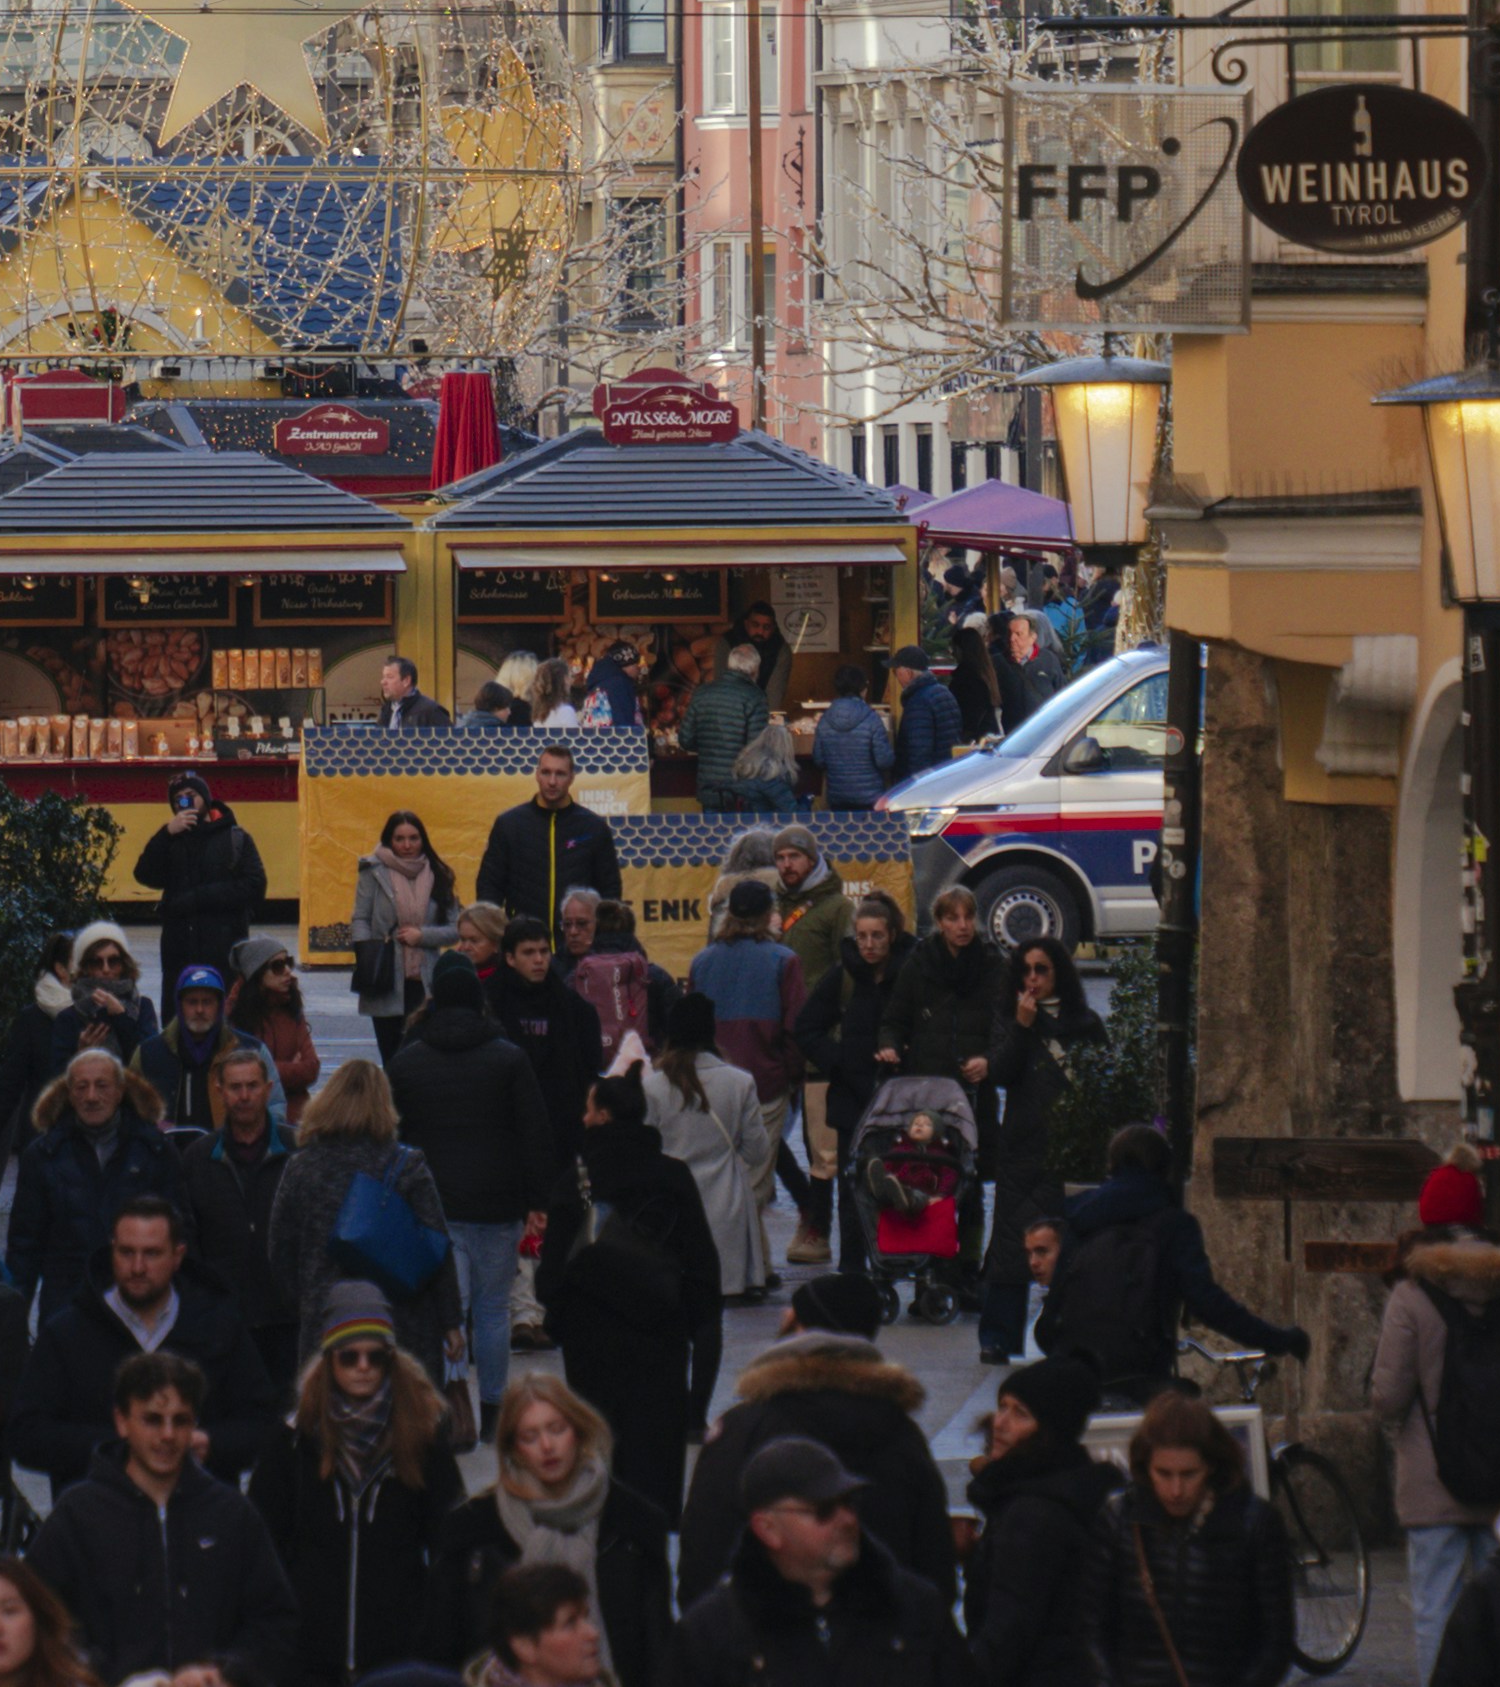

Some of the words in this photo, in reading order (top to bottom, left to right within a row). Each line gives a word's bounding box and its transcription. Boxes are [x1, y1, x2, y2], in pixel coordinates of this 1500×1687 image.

[1016, 162, 1162, 224] FFP
[1260, 159, 1469, 205] WEINHAUS
[1331, 204, 1402, 226] TYROL
[286, 426, 379, 442] Zentrumsverein
[661, 587, 704, 600] Madeln
